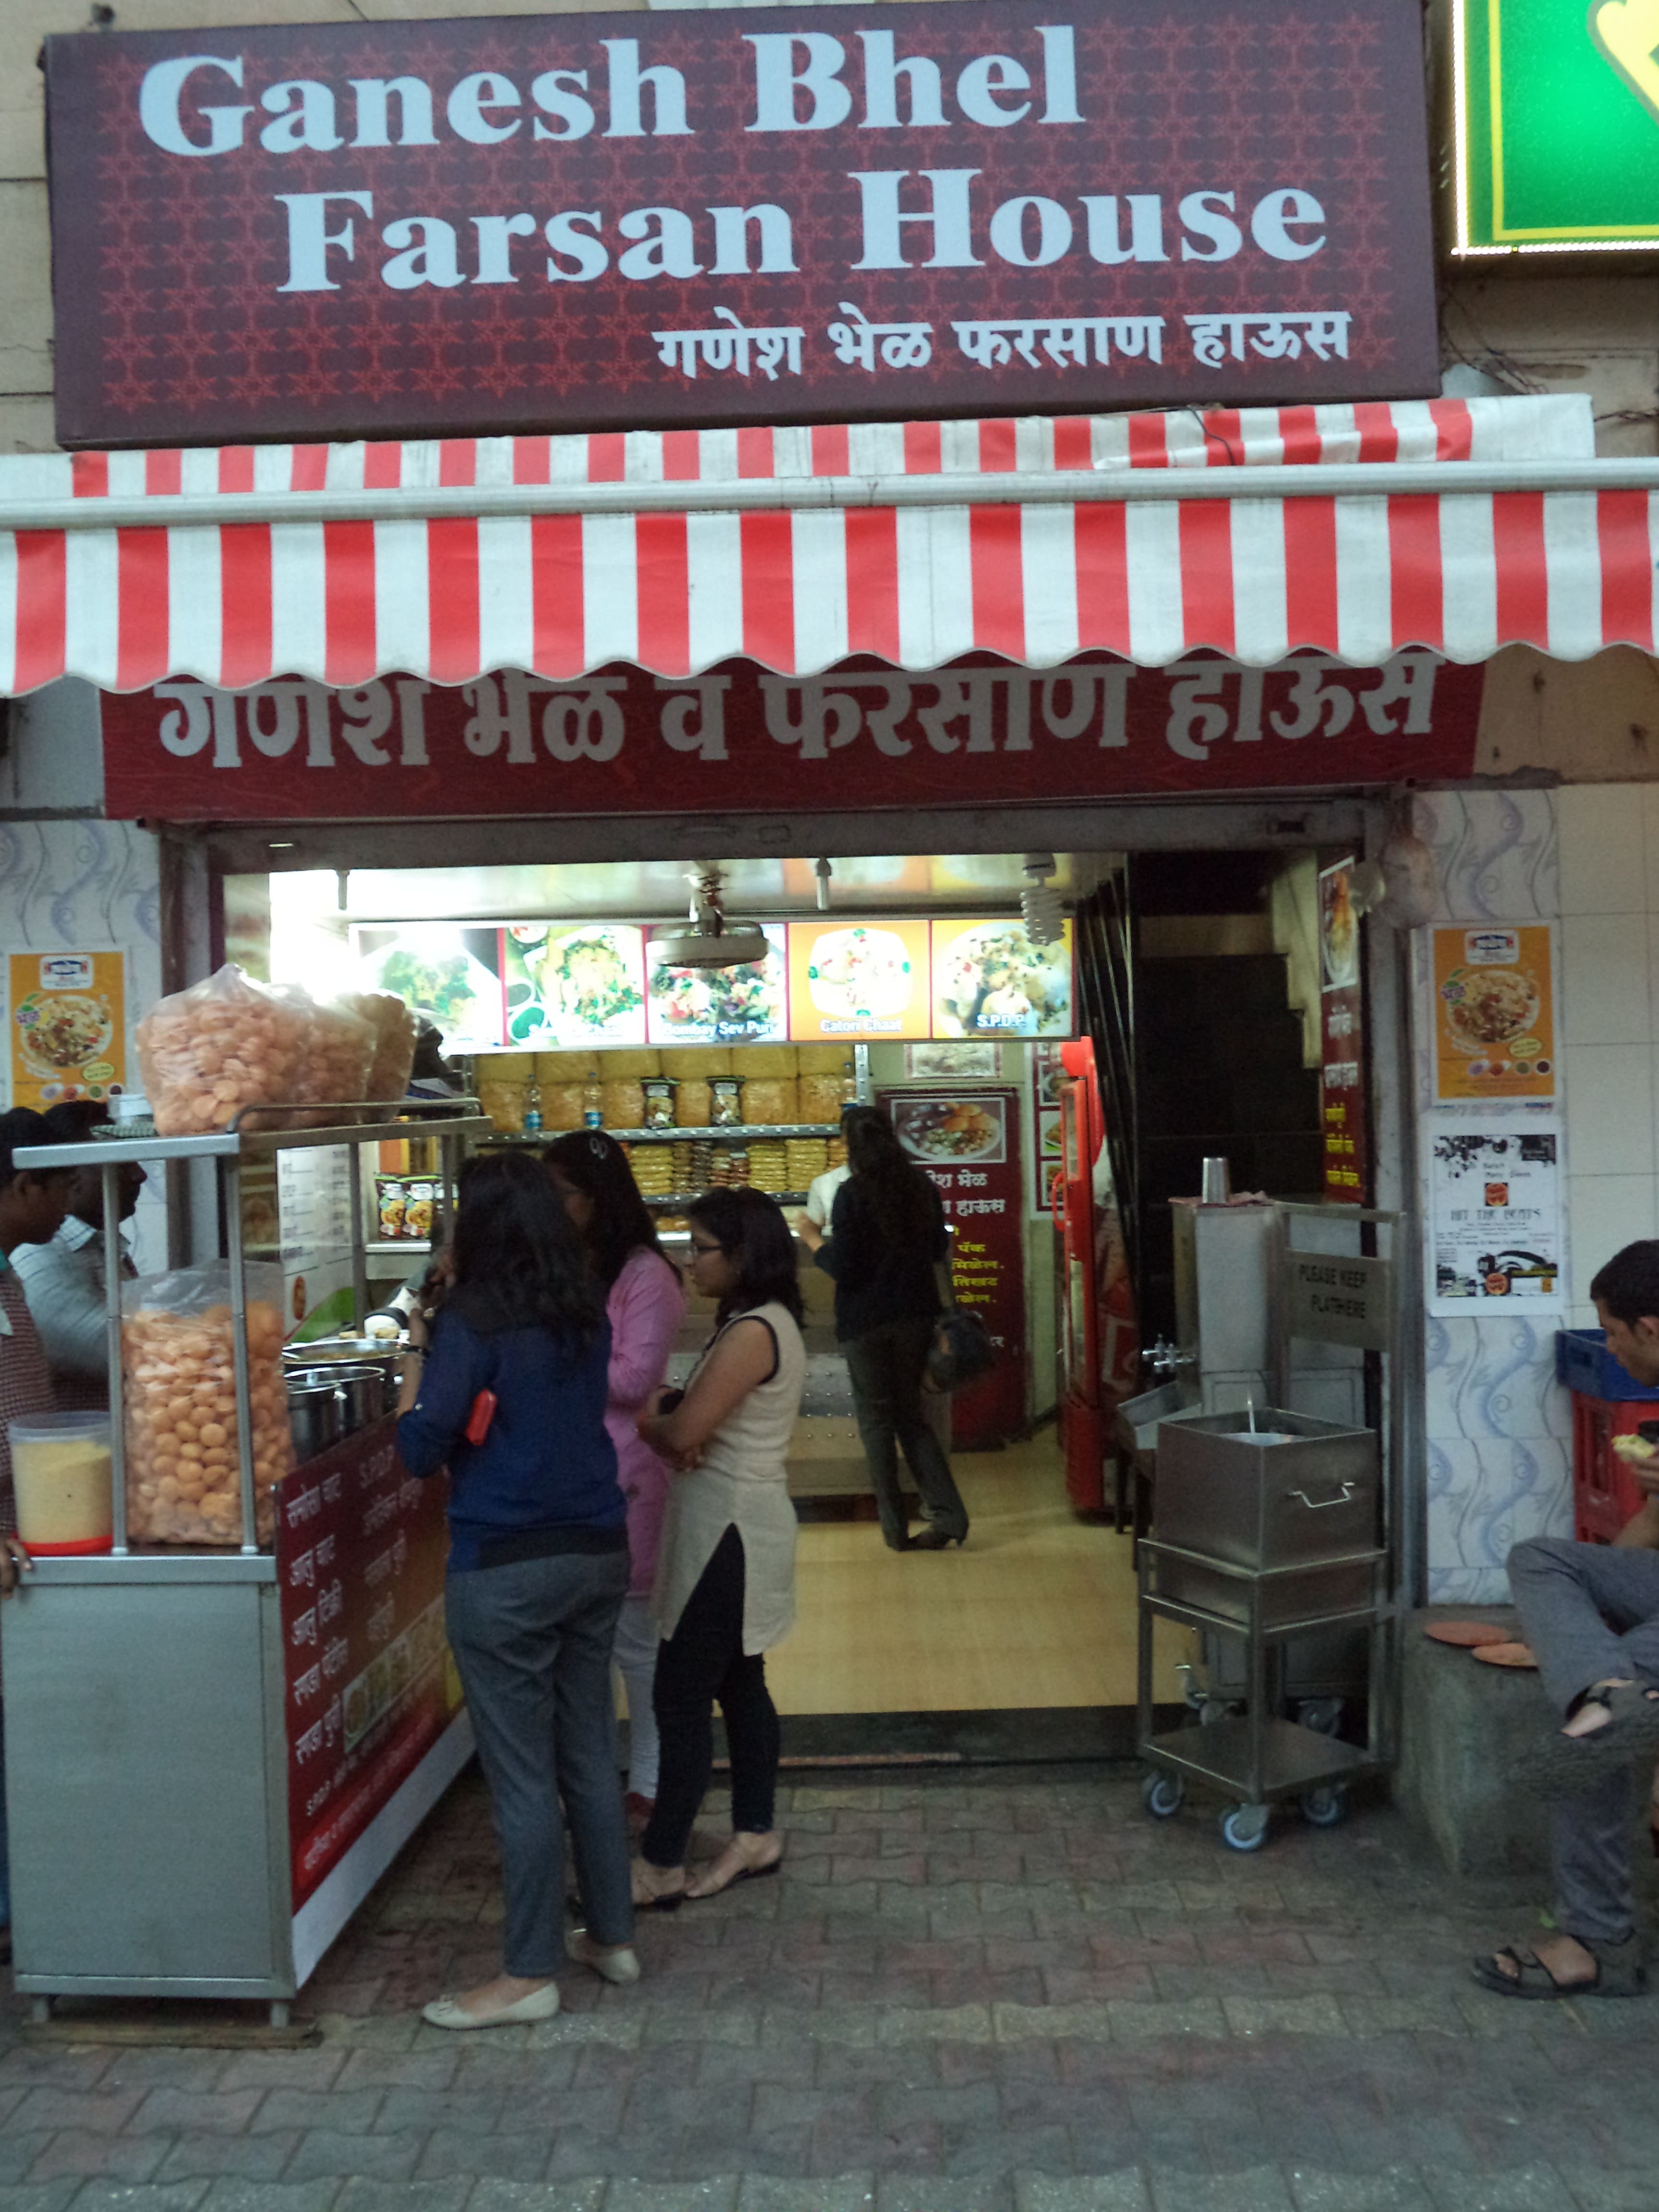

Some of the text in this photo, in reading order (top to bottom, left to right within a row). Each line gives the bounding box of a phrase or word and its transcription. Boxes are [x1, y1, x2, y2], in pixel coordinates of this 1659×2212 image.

[138, 25, 1086, 157] Ganesh Bhel
[274, 168, 1327, 292] Farsan House
[651, 301, 1353, 381] गणेश भेळ फरसाण हाऊस
[654, 674, 732, 760] व
[758, 662, 1137, 759] फरसाण
[1163, 651, 1443, 761] हाऊस
[662, 1022, 717, 1039] Bombay
[718, 1021, 745, 1035] Sev
[862, 1017, 902, 1032] Chaat
[1299, 1264, 1367, 1289] PLEASE KEEP
